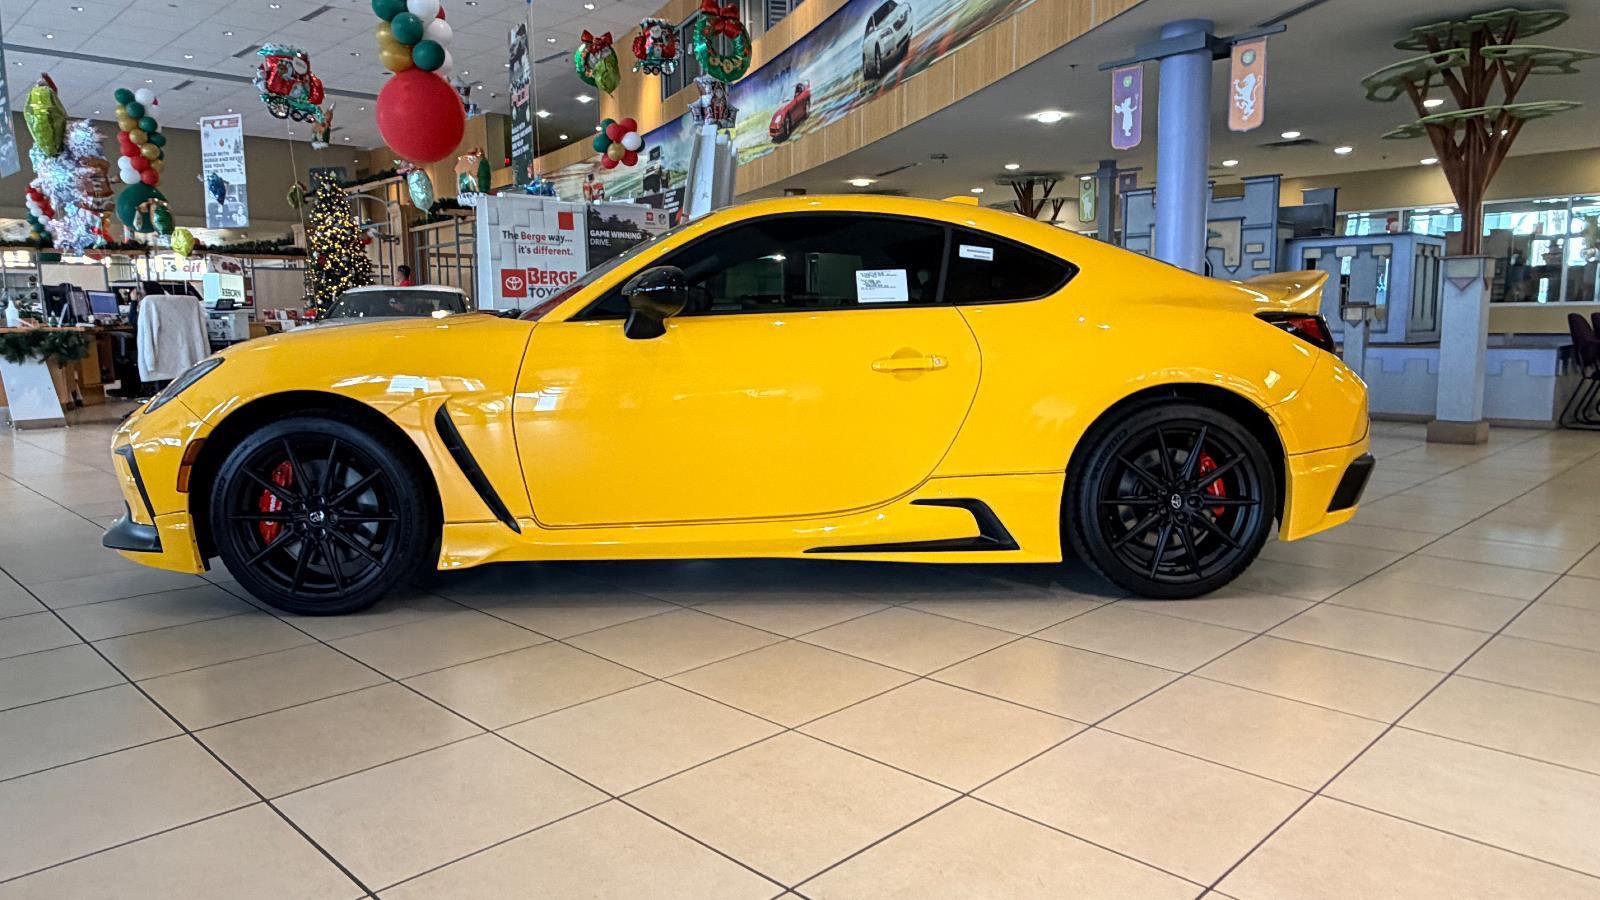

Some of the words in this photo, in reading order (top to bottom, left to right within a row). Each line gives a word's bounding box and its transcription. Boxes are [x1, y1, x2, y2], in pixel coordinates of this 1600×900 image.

[502, 230, 519, 240] The
[520, 231, 546, 243] Berge
[548, 234, 573, 244] way...
[590, 230, 610, 238] GAME
[611, 230, 642, 240] WINNING
[590, 238, 612, 246] DRIVE.
[518, 245, 532, 254] it's
[532, 246, 574, 256] different.
